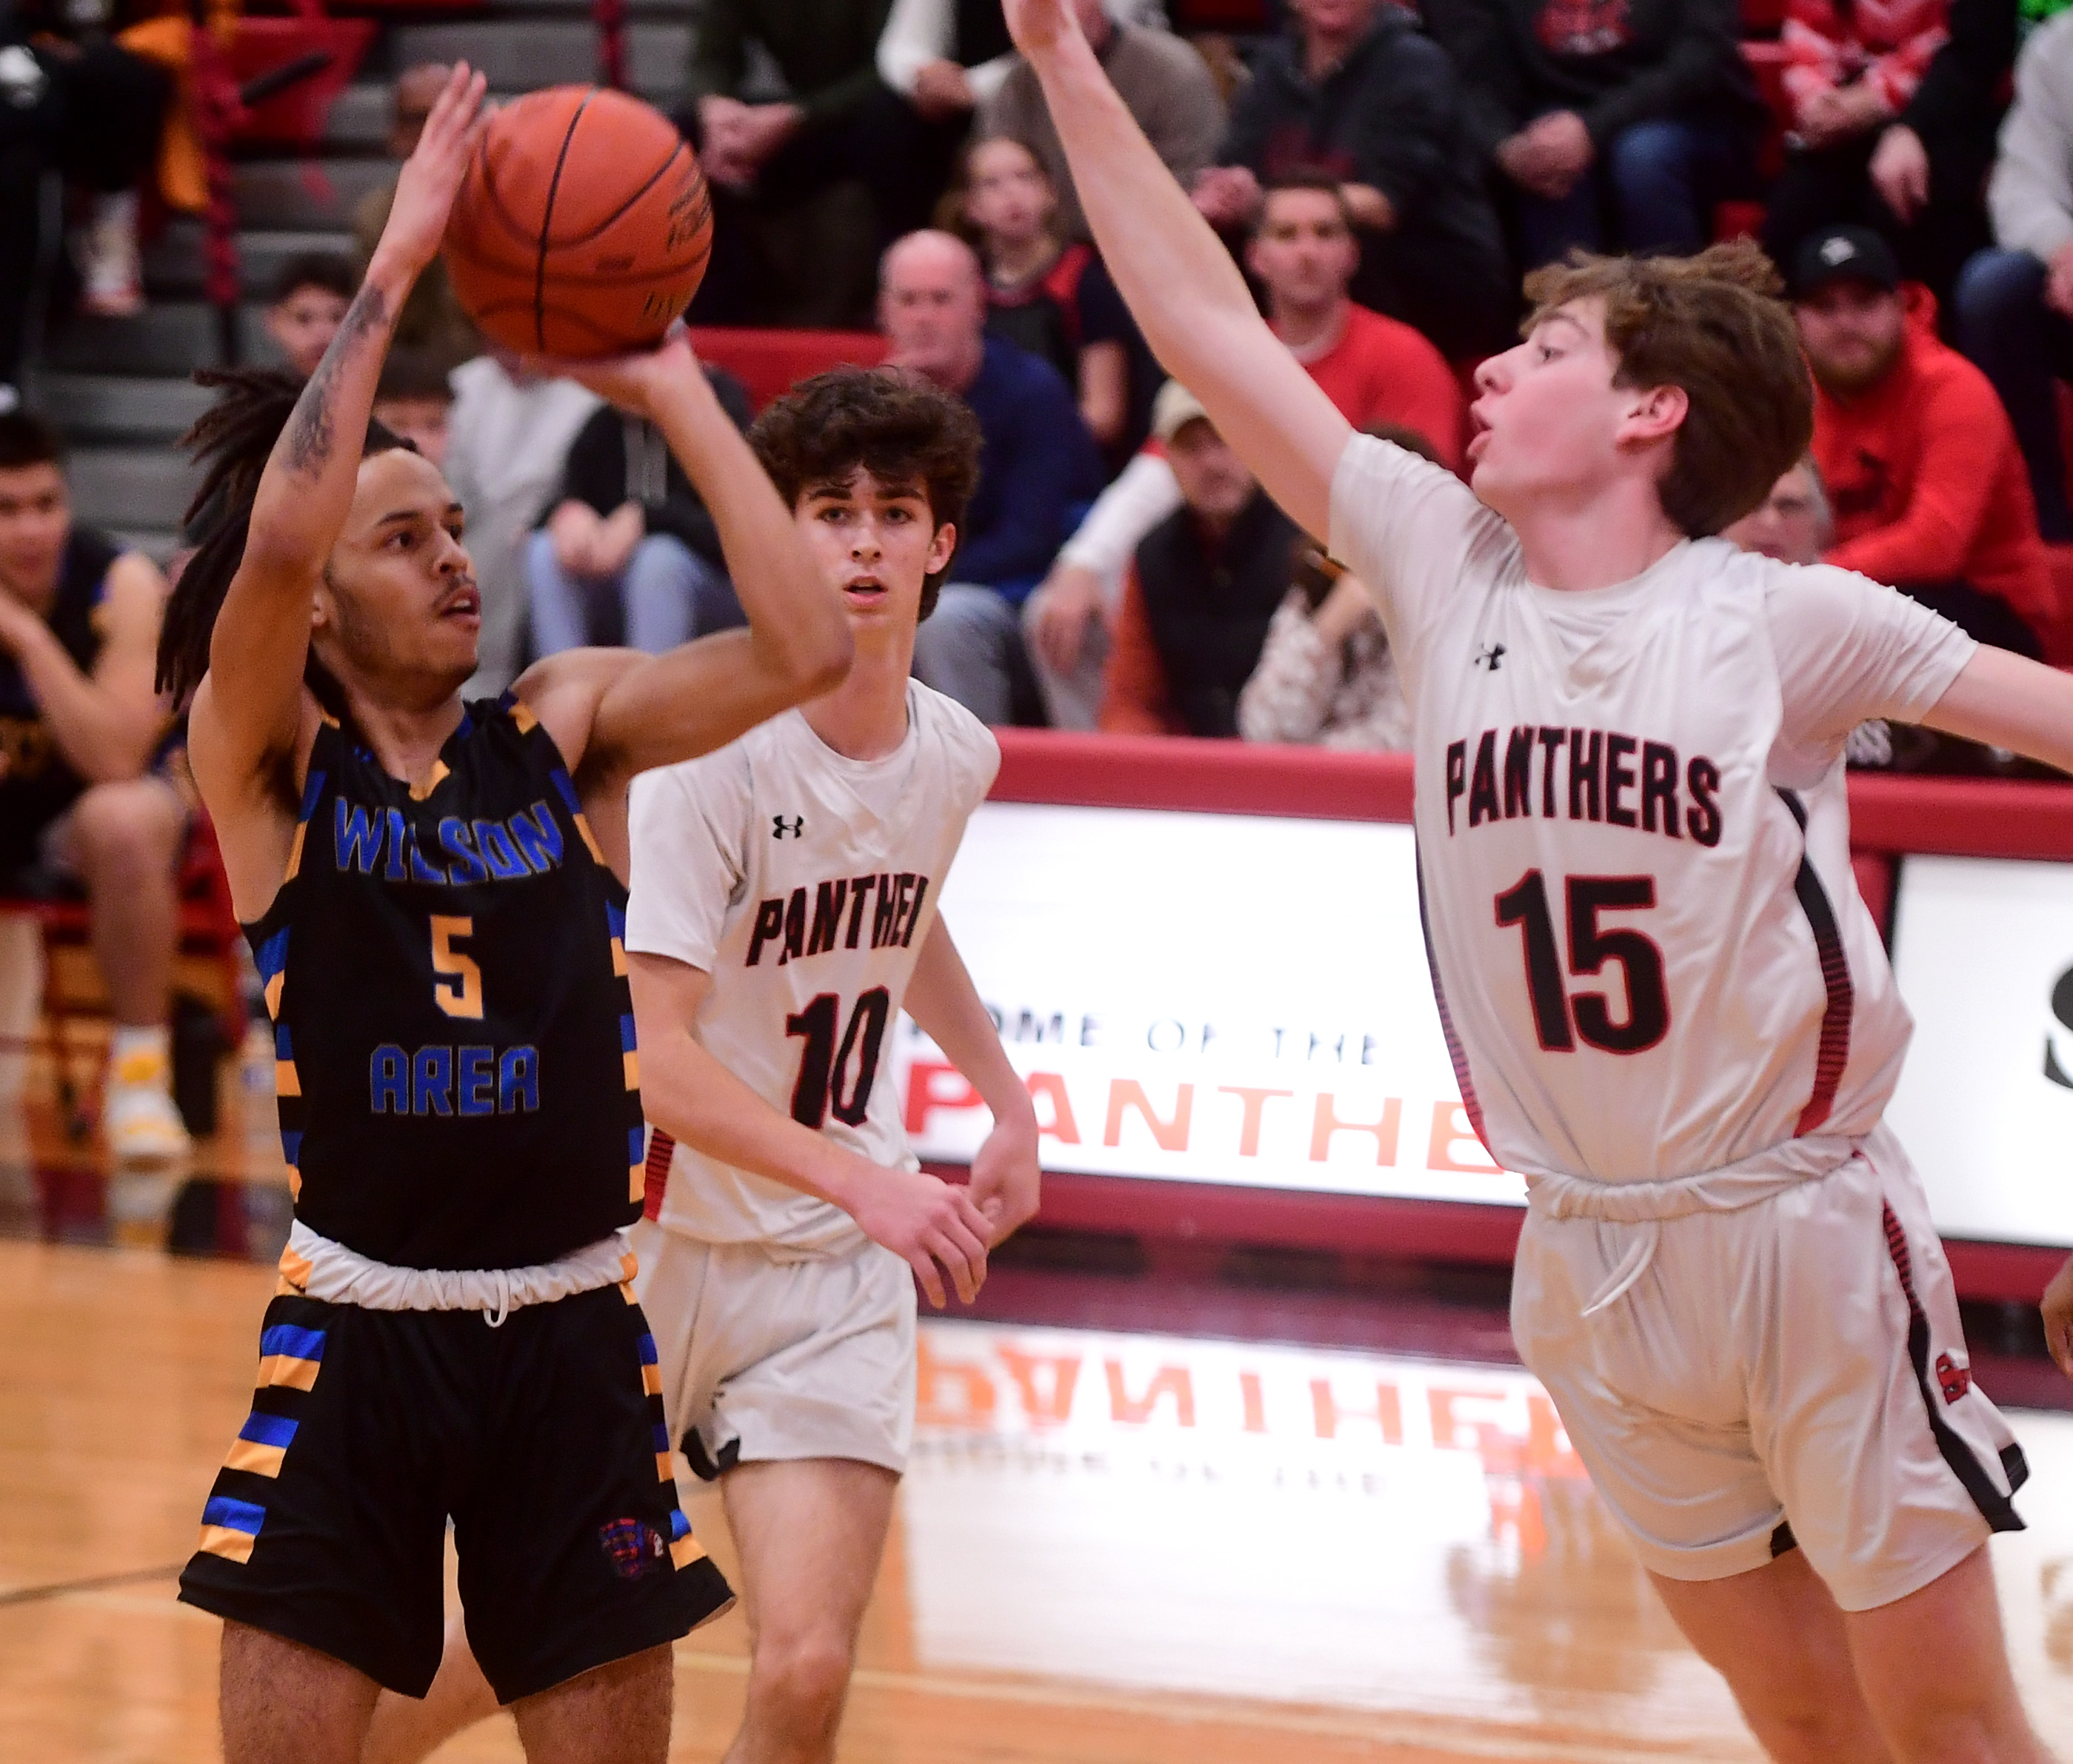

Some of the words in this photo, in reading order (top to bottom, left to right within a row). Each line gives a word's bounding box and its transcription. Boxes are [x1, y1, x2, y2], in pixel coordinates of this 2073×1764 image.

[335, 795, 564, 886] WILSON
[1446, 723, 1723, 848] PANTHERS
[430, 913, 484, 1020] 5
[1493, 867, 1672, 1056] 15
[370, 1043, 540, 1117] AREA
[785, 984, 891, 1130] 10
